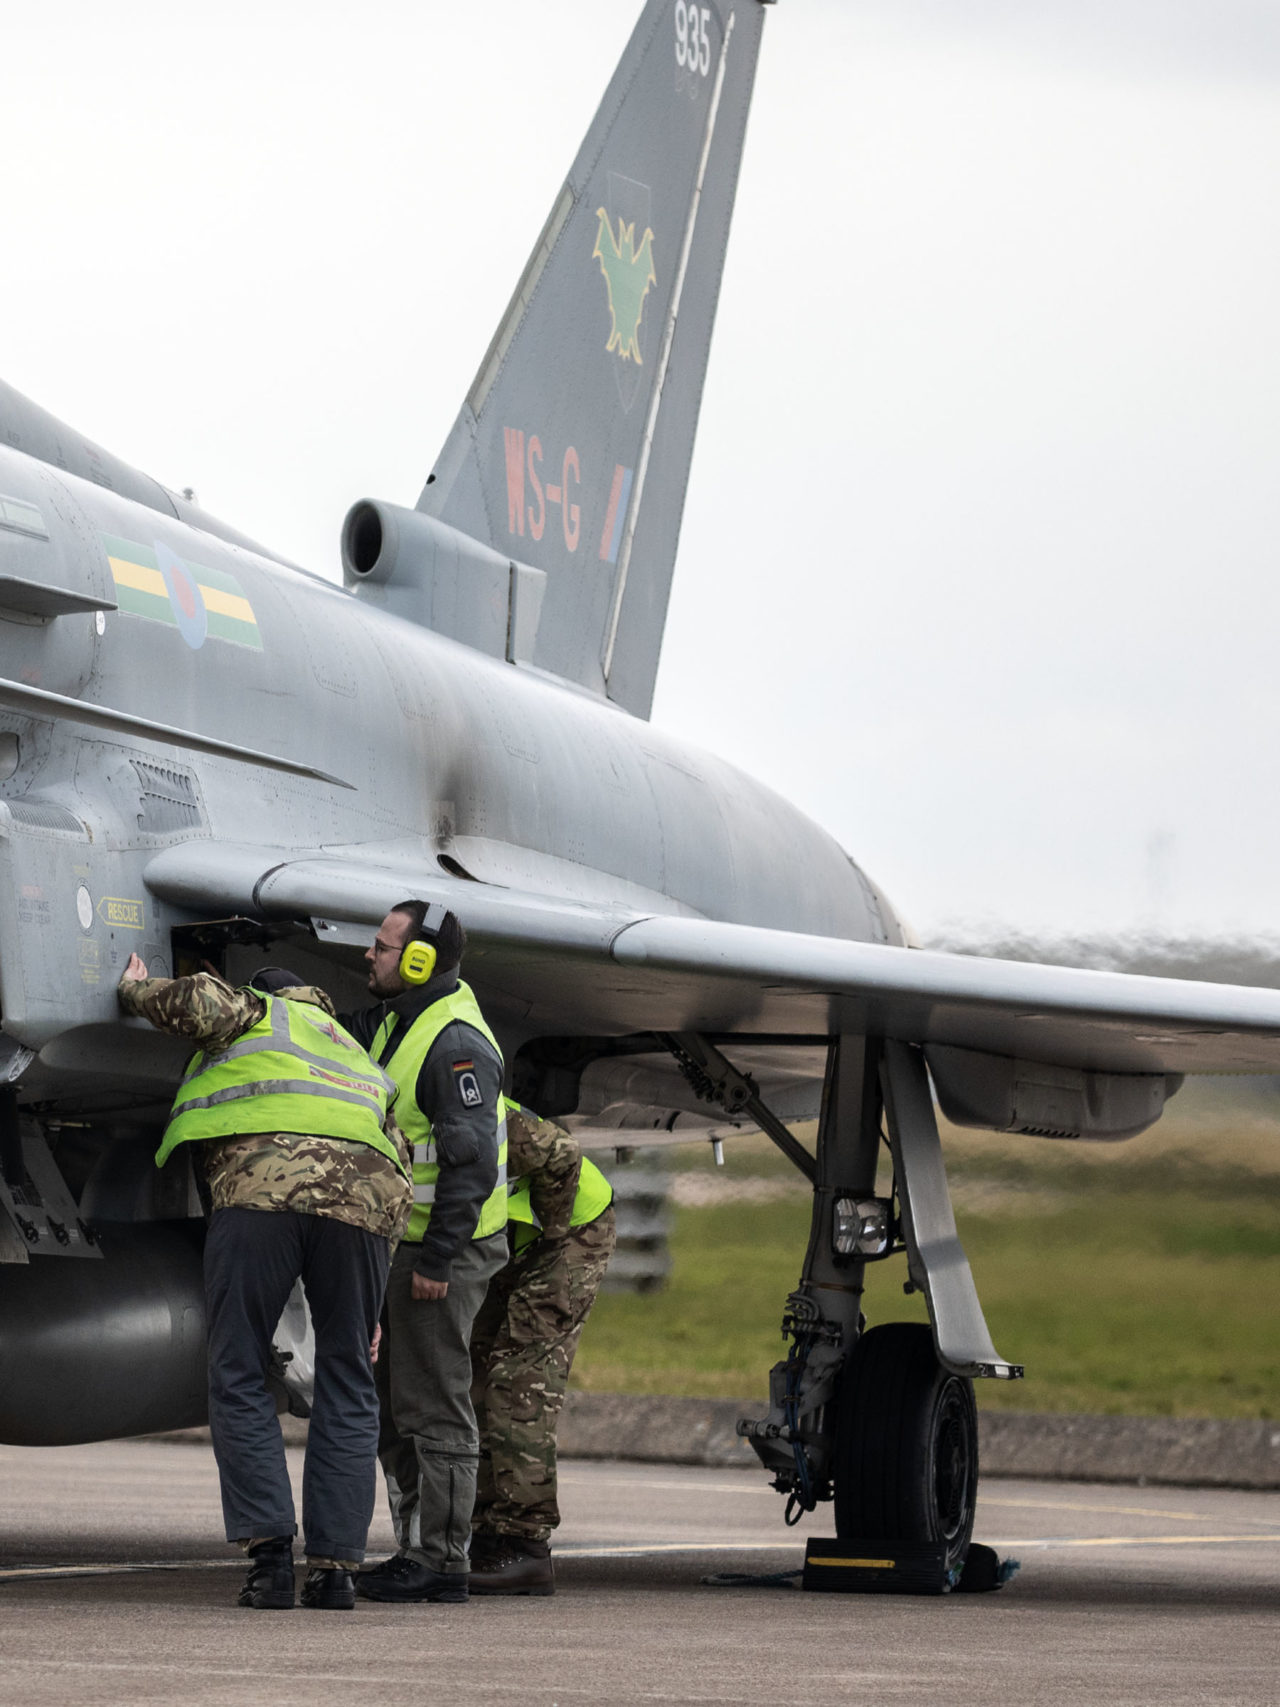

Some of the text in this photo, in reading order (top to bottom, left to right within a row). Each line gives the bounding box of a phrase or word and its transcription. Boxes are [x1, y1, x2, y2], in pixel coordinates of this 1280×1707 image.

[675, 0, 710, 77] 935
[504, 426, 581, 552] WS-G
[107, 902, 139, 923] RESCUE
